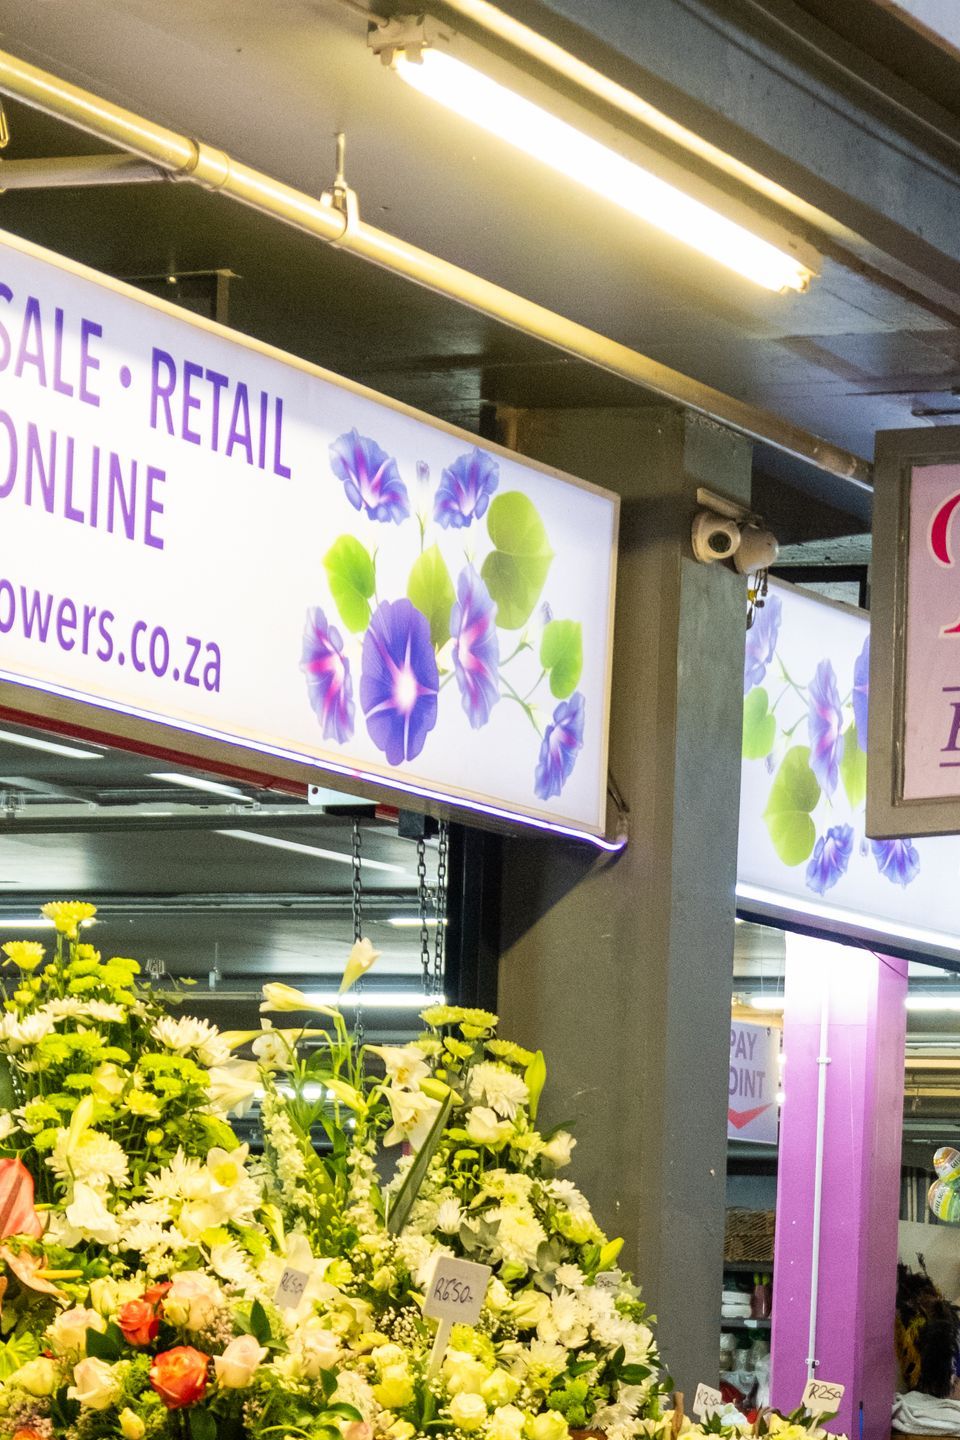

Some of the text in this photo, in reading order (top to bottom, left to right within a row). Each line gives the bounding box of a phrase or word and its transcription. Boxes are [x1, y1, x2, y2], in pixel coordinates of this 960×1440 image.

[150, 346, 292, 480] RETAIL
[0, 409, 167, 551] ONLINE
[0, 578, 222, 693] owers.co.za
[729, 1028, 757, 1061] PAY
[729, 1065, 766, 1099] OINT
